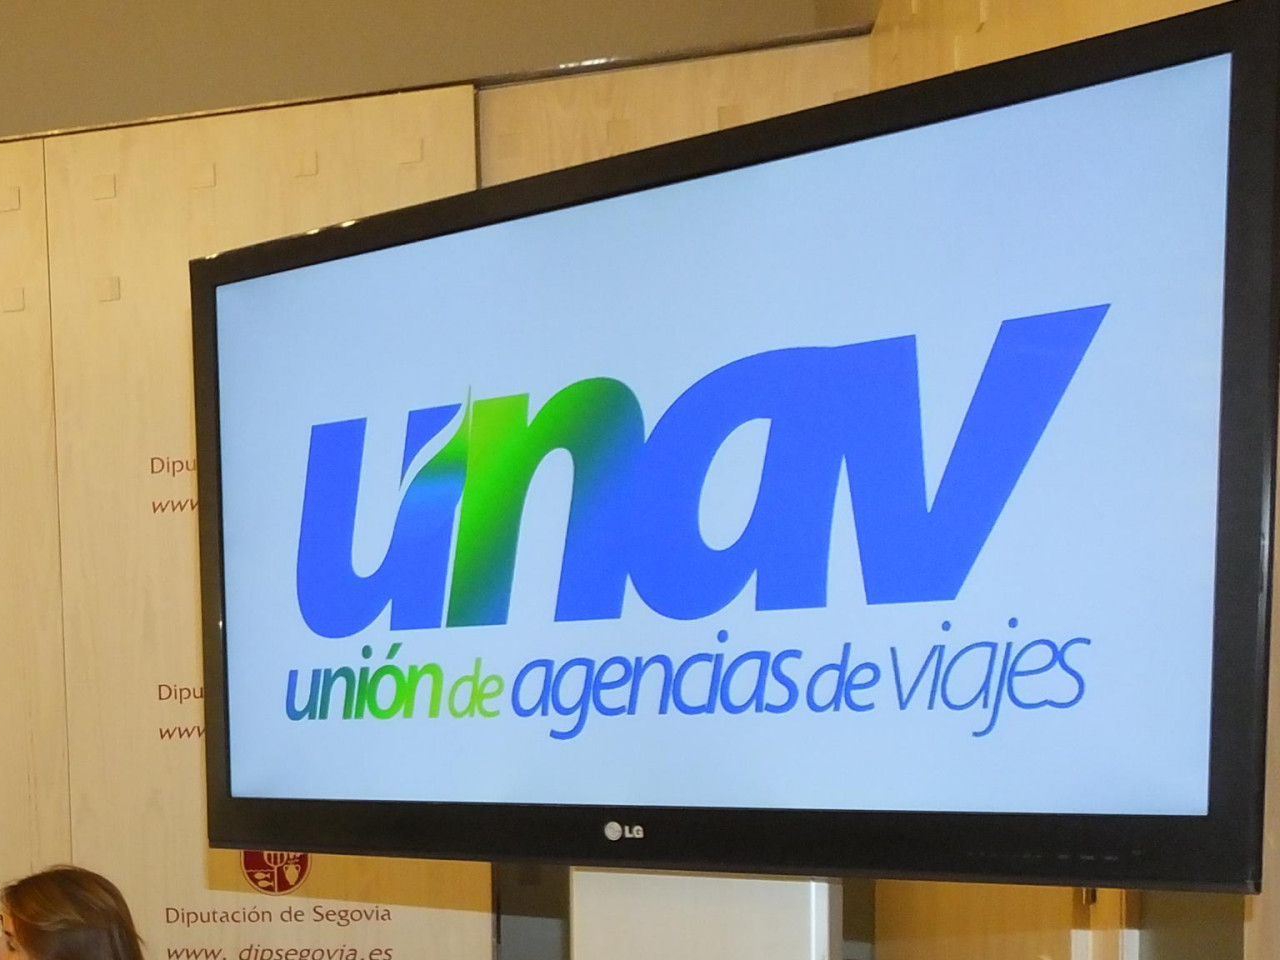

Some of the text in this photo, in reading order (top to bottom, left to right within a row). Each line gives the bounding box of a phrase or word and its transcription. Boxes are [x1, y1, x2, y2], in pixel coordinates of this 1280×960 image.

[296, 303, 1111, 638] unav
[511, 630, 803, 740] agencias
[806, 642, 881, 712] de
[890, 617, 1091, 737] viajes
[624, 825, 644, 838] LG
[166, 905, 394, 928] Diputación de Segovia
[167, 948, 226, 960] www.
